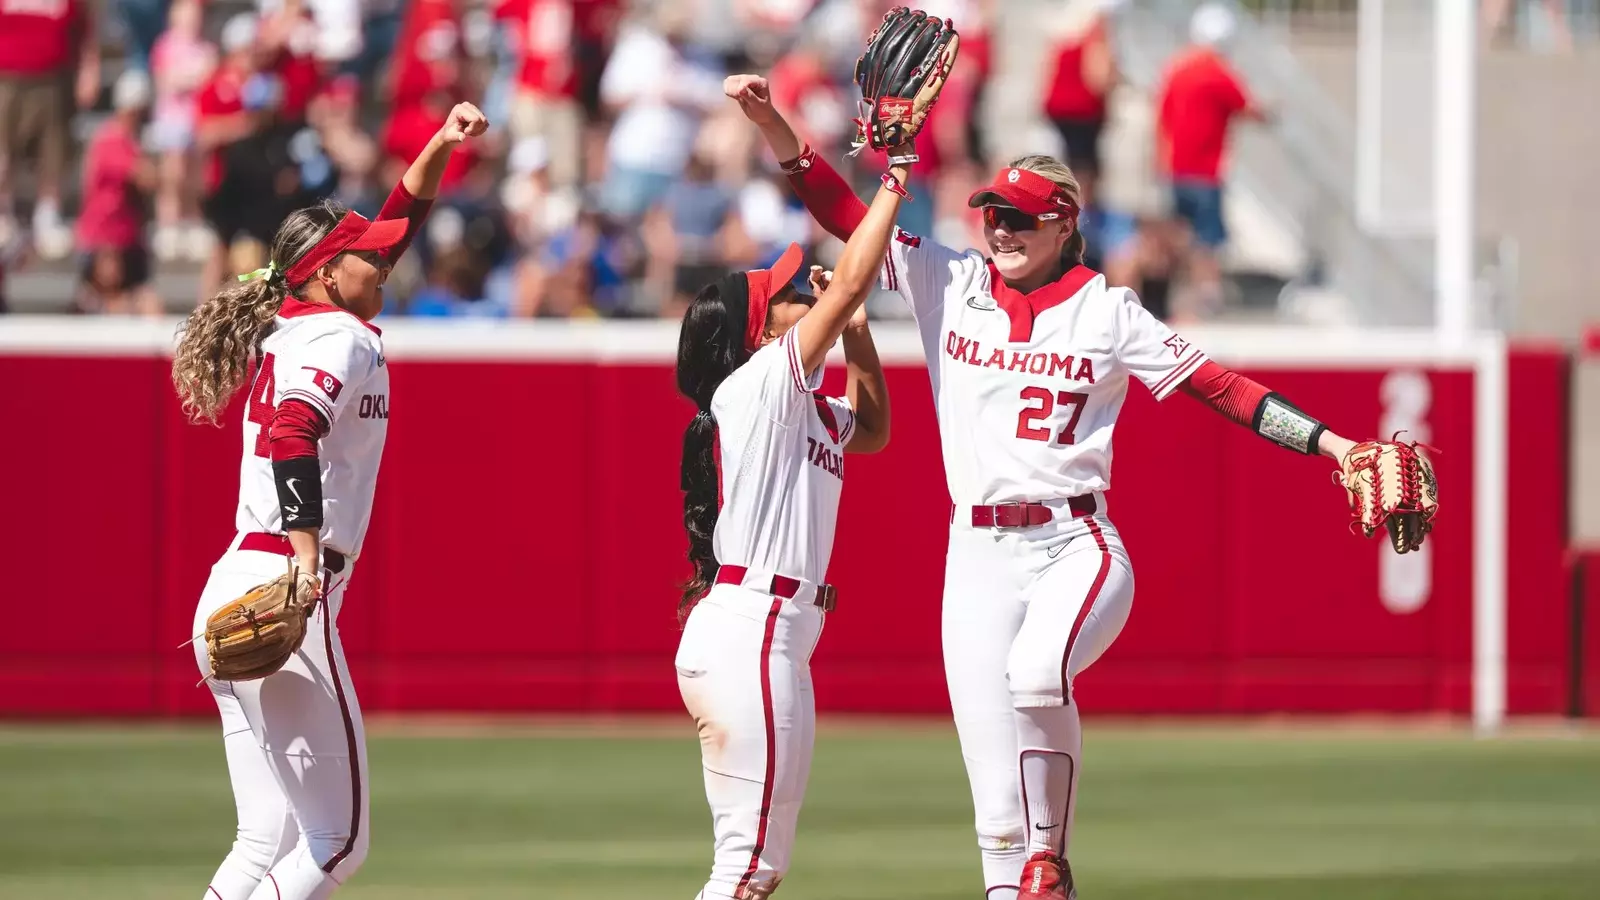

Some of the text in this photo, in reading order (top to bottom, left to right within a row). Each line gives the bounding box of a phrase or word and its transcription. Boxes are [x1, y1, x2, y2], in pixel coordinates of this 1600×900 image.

[1008, 169, 1020, 183] OU
[946, 330, 1095, 384] OKLAHOMA
[323, 376, 334, 393] OU
[1016, 386, 1089, 445] 27
[1378, 368, 1434, 614] 20
[284, 505, 299, 522] 24
